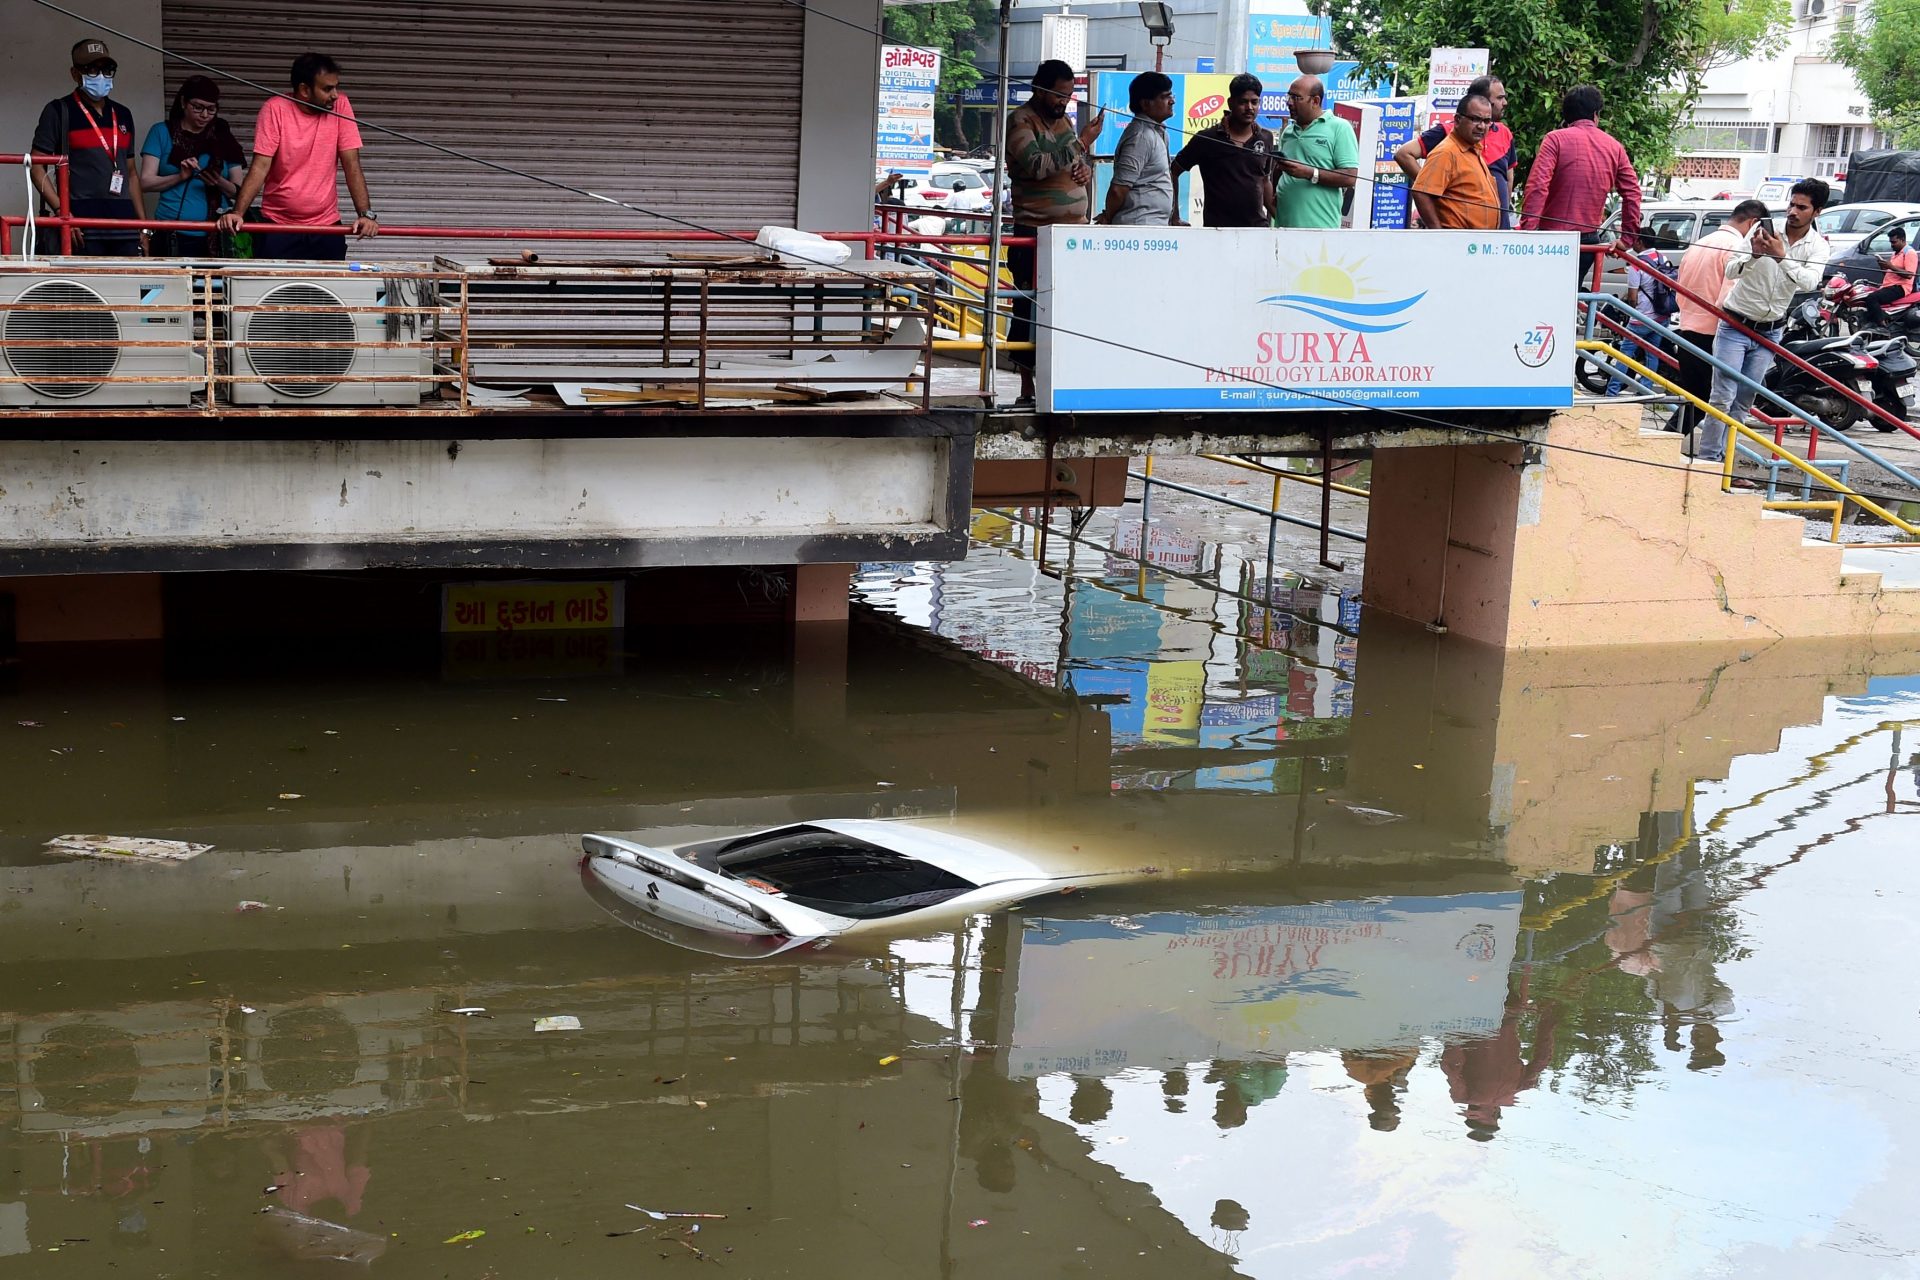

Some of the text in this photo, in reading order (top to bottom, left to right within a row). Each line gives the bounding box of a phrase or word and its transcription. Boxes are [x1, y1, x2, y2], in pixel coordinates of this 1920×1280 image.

[894, 79, 930, 88] CENTER
[964, 89, 983, 100] BANK
[1326, 89, 1379, 101] DVERTISING
[1440, 86, 1459, 96] 99251
[1194, 97, 1220, 117] TAG
[1187, 117, 1218, 128] WOR
[1104, 239, 1140, 251] 99049
[1143, 239, 1179, 251] 59994
[1502, 244, 1535, 255] 76004
[1538, 244, 1570, 256] 34448
[1256, 331, 1372, 364] SURYA
[1205, 365, 1434, 383] PATHOLOGY LABORATORY
[1220, 389, 1256, 400] E-mail
